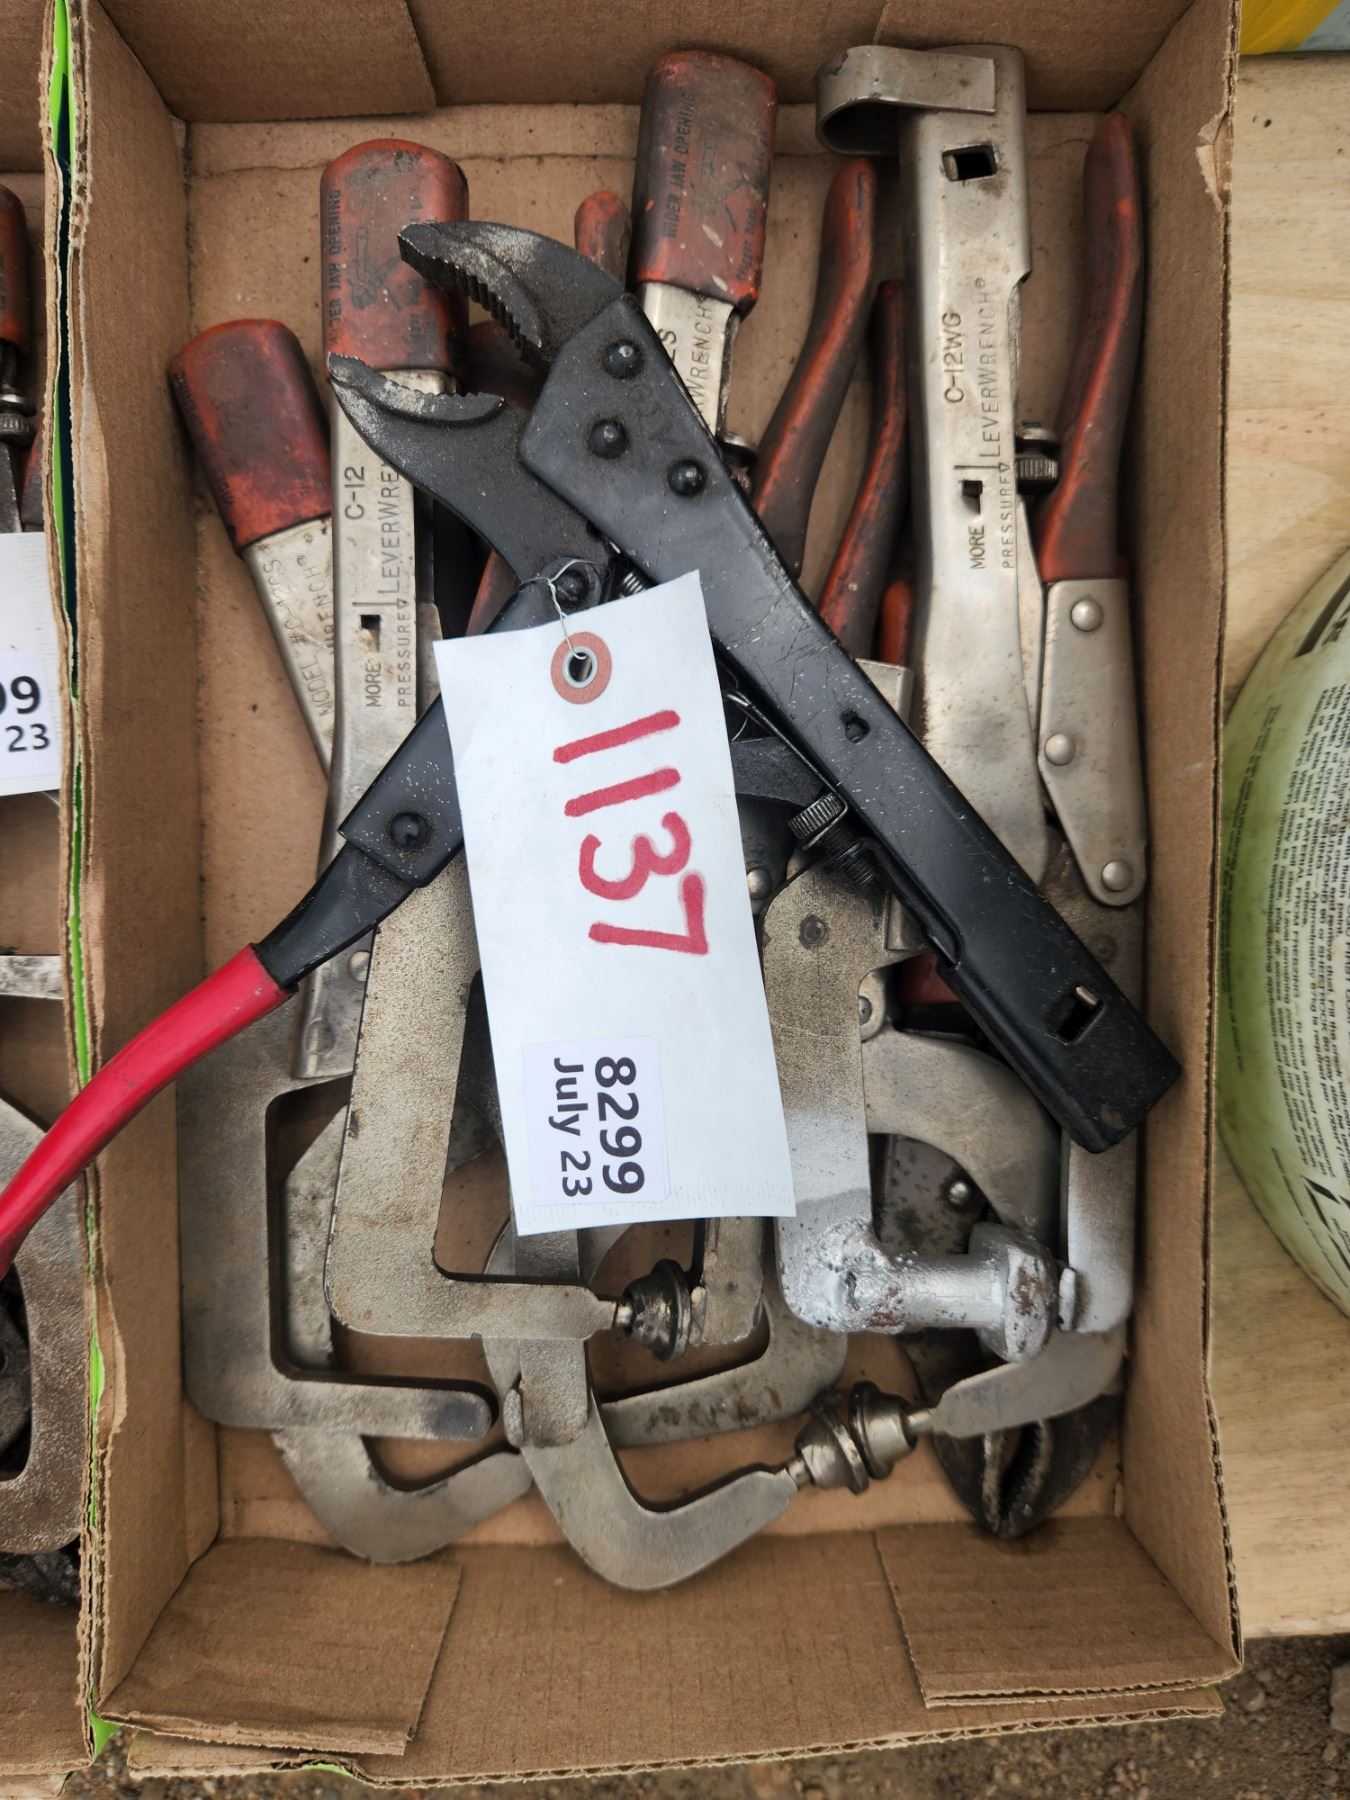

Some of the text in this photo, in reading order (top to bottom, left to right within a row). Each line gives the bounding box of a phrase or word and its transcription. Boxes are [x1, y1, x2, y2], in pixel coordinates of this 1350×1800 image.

[661, 92, 696, 239] WIDER JAW OPENING
[326, 188, 343, 255] OPENING
[327, 300, 343, 346] DER
[941, 311, 967, 404] C-12WG
[344, 466, 366, 521] C-12
[377, 462, 402, 594] LEVERWRE
[998, 475, 1015, 569] PRESSURE
[966, 524, 986, 570] MORE
[364, 662, 383, 708] MORE
[397, 611, 412, 707] PRESSURE
[5, 723, 51, 752] 23
[552, 709, 709, 956] 1137
[548, 1057, 594, 1198] July 23
[594, 1056, 646, 1195] 8299
